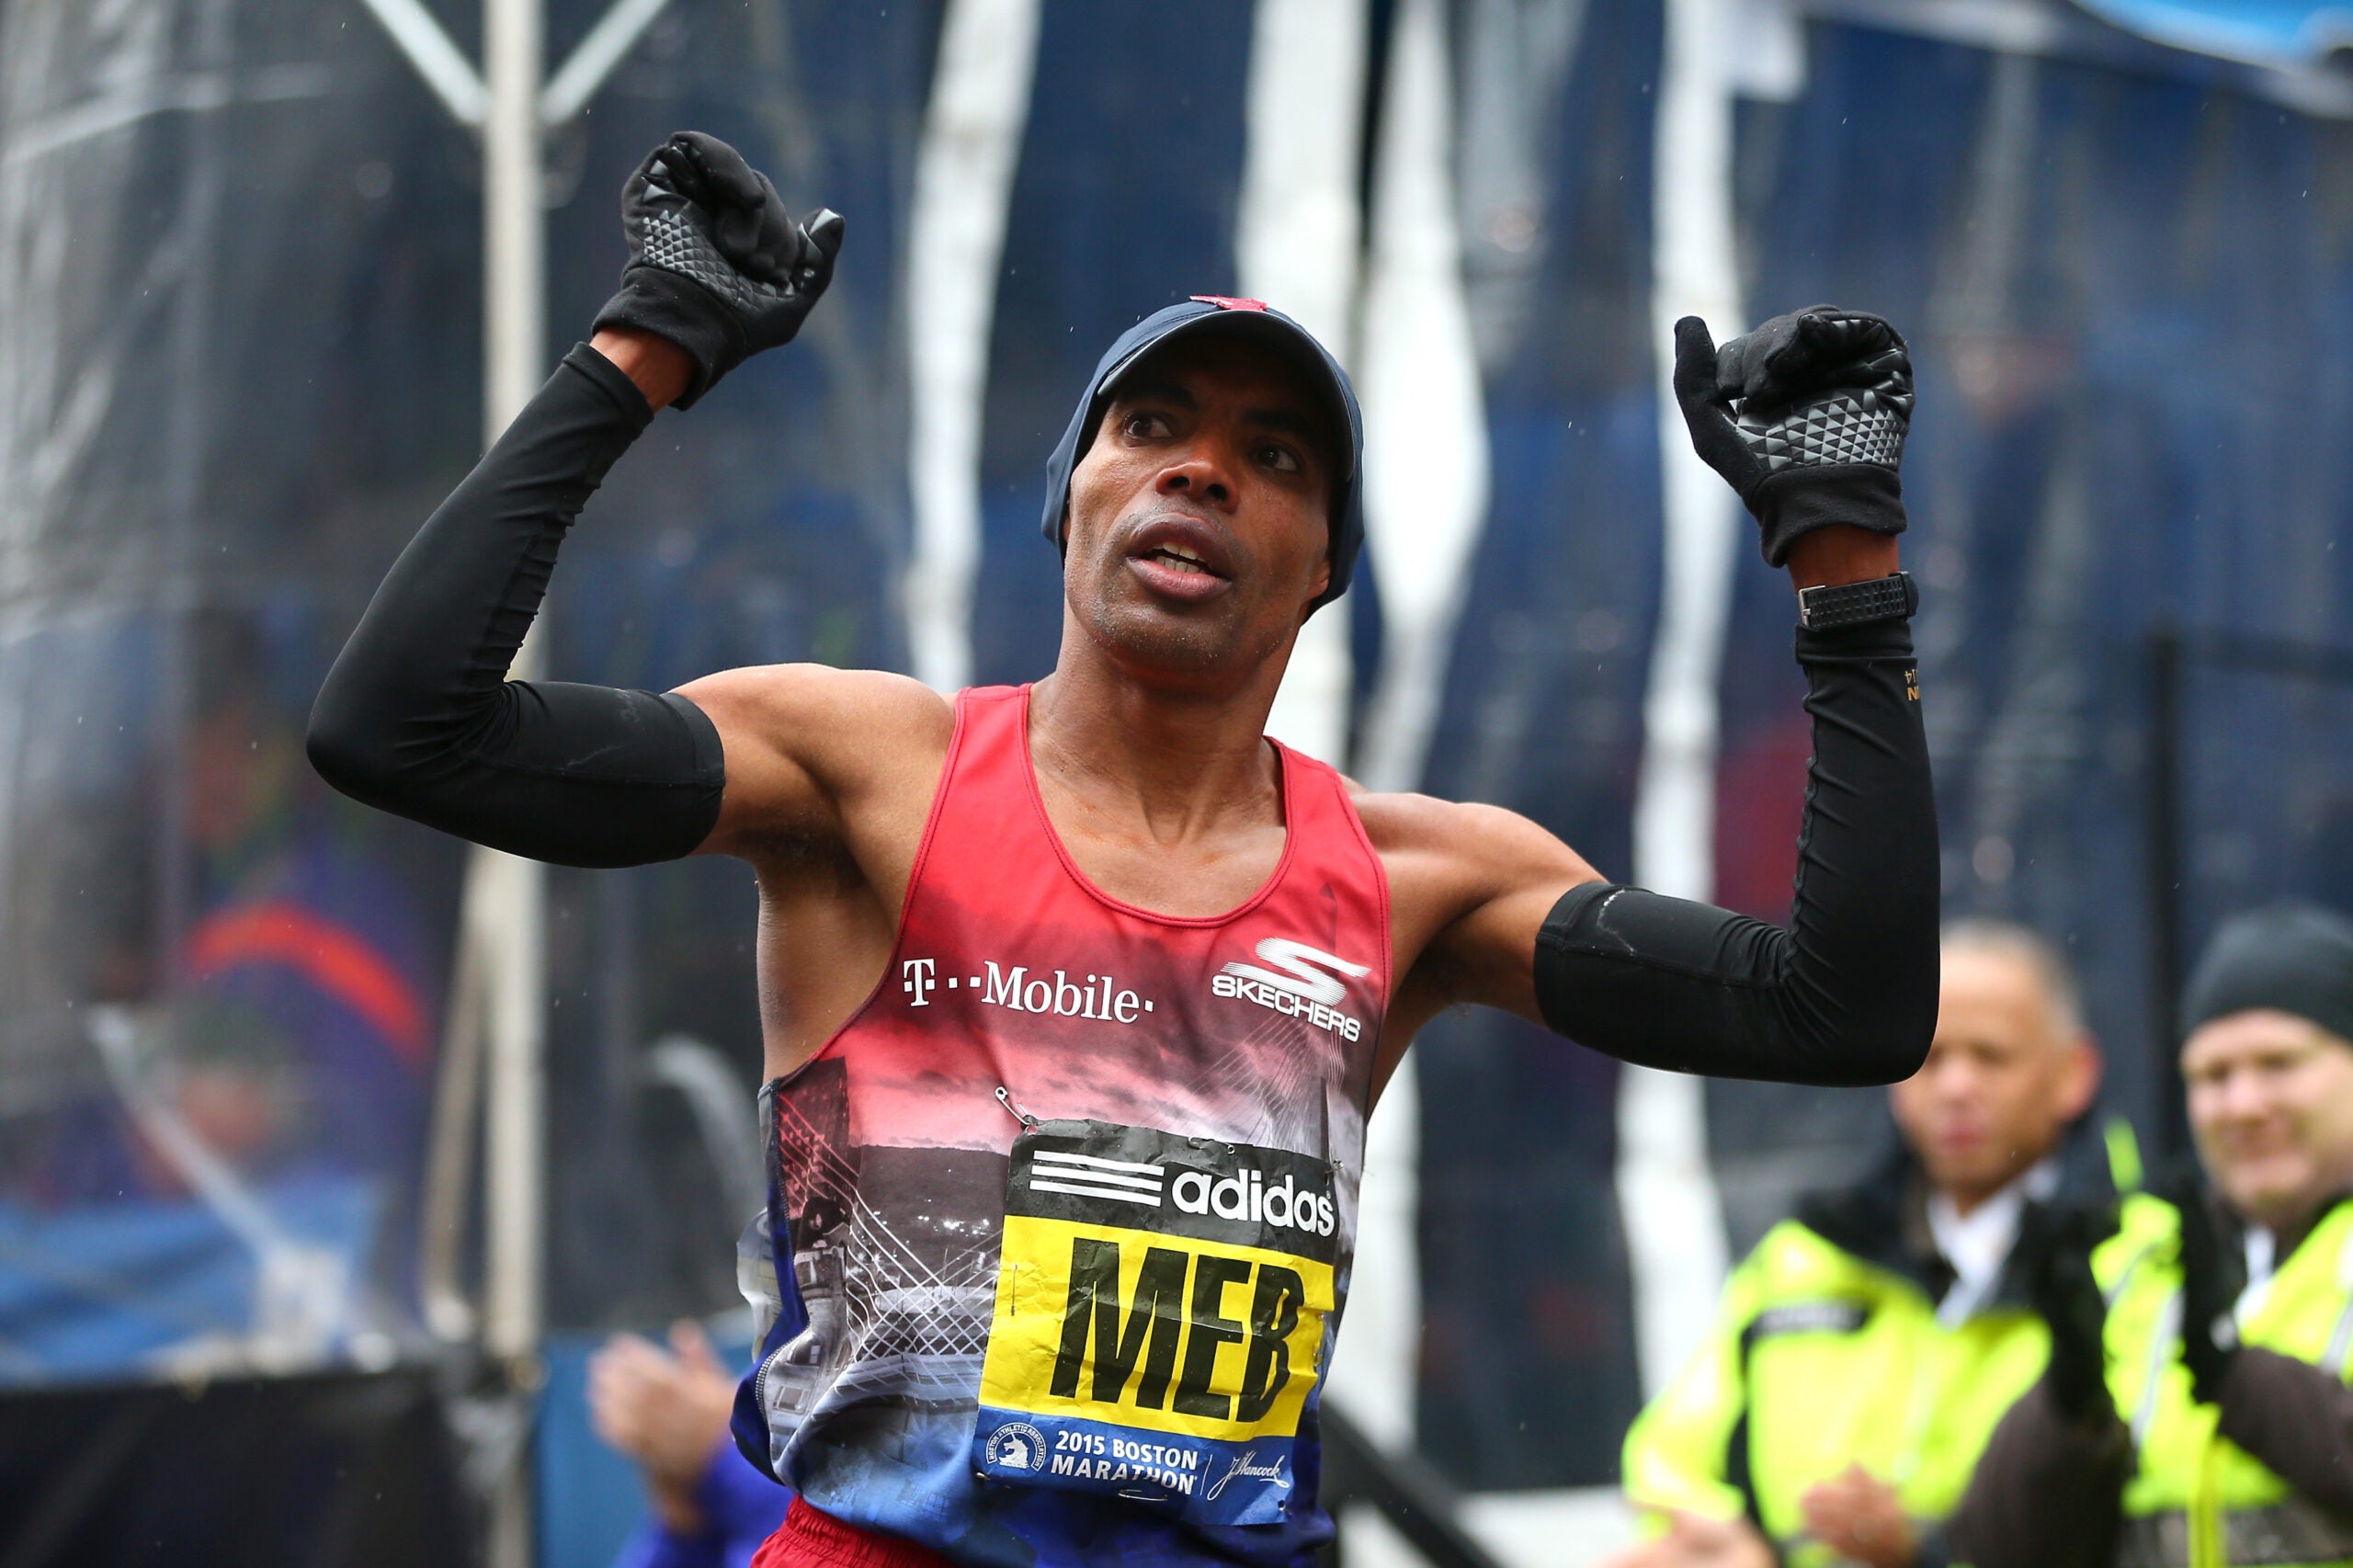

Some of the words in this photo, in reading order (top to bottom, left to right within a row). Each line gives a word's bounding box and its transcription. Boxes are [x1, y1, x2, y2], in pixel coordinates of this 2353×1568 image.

[1212, 975, 1360, 1043] SKECHERS
[1172, 1169, 1335, 1237] adidas
[1050, 1237, 1305, 1423] MEB
[997, 1424, 1029, 1437] ATHLETIC
[1027, 1428, 1045, 1468] ASSOCIATION
[1055, 1430, 1105, 1455] 2015
[1112, 1438, 1198, 1471] BOSTON
[1051, 1454, 1195, 1495] MARATHON
